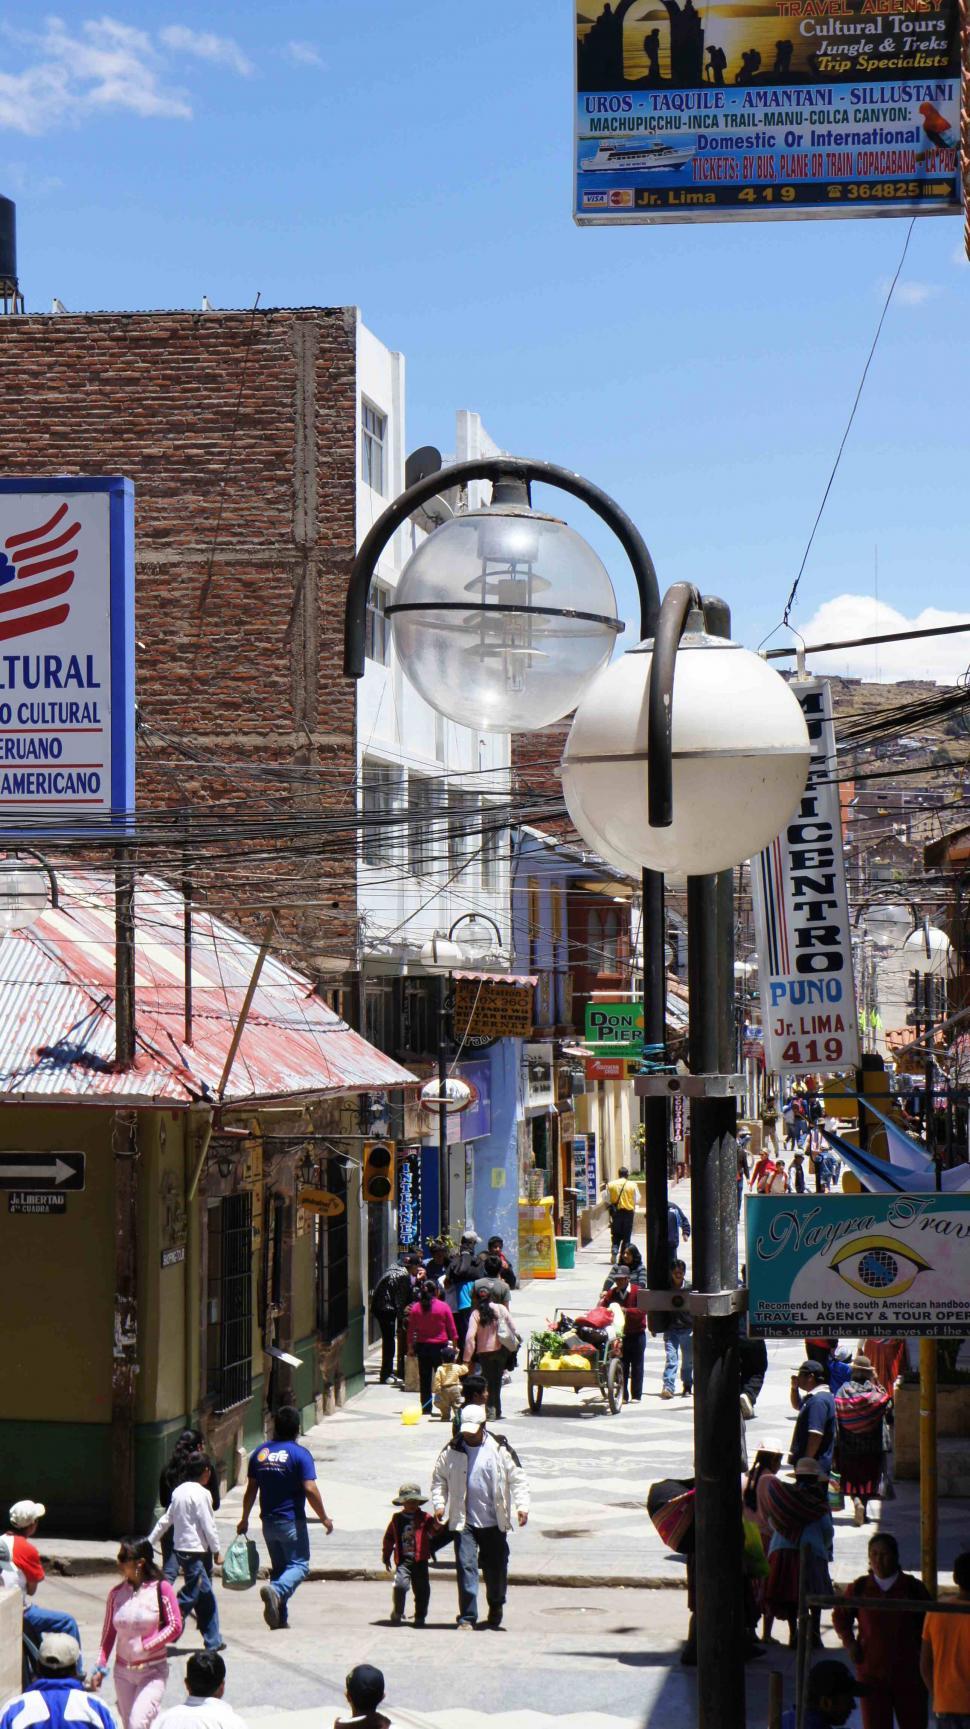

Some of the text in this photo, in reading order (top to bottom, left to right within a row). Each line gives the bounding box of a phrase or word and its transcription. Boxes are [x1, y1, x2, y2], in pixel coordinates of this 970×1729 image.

[776, 0, 854, 17] TRAVEL
[800, 15, 946, 36] Cultural Tours
[816, 36, 948, 56] Jungle & Treks
[818, 53, 949, 72] Trip Specialists
[585, 95, 633, 113] UROS
[650, 92, 726, 112] TAQUILE
[742, 88, 833, 108] AMANTANI
[850, 84, 953, 105] SILLUSTANI
[854, 107, 912, 123] CANYON:
[697, 126, 920, 151] Domestic Or International
[691, 157, 740, 181] TICKETS:
[743, 156, 757, 180] BY
[757, 154, 778, 184] BUS,
[780, 153, 809, 178] PLANE
[811, 153, 823, 176] OR
[826, 151, 853, 177] TRAIN
[857, 149, 917, 176] COPACABANA
[587, 195, 604, 203] VISA
[638, 190, 716, 205] Jr. Lima
[847, 182, 920, 199] 364825
[17, 701, 101, 724] CULTURAL
[1, 772, 101, 794] AMERICANO
[770, 978, 843, 1007] PUNO
[590, 1011, 633, 1027] DON
[774, 1018, 796, 1037] Jr.
[800, 1014, 845, 1035] LIMA
[782, 1038, 844, 1064] 419
[757, 1207, 875, 1260] Nayra
[759, 1301, 818, 1310] Recomended
[822, 1301, 833, 1311] by
[836, 1301, 850, 1309] the
[853, 1301, 879, 1309] south
[882, 1300, 927, 1309] American
[756, 1312, 808, 1321] TRAVEL
[817, 1312, 873, 1321] AGENCY
[879, 1312, 888, 1321] &
[894, 1312, 931, 1321] TOUR
[787, 1326, 823, 1336] Sacred
[873, 1326, 891, 1335] the
[926, 1327, 938, 1335] of
[944, 1326, 962, 1335] the
